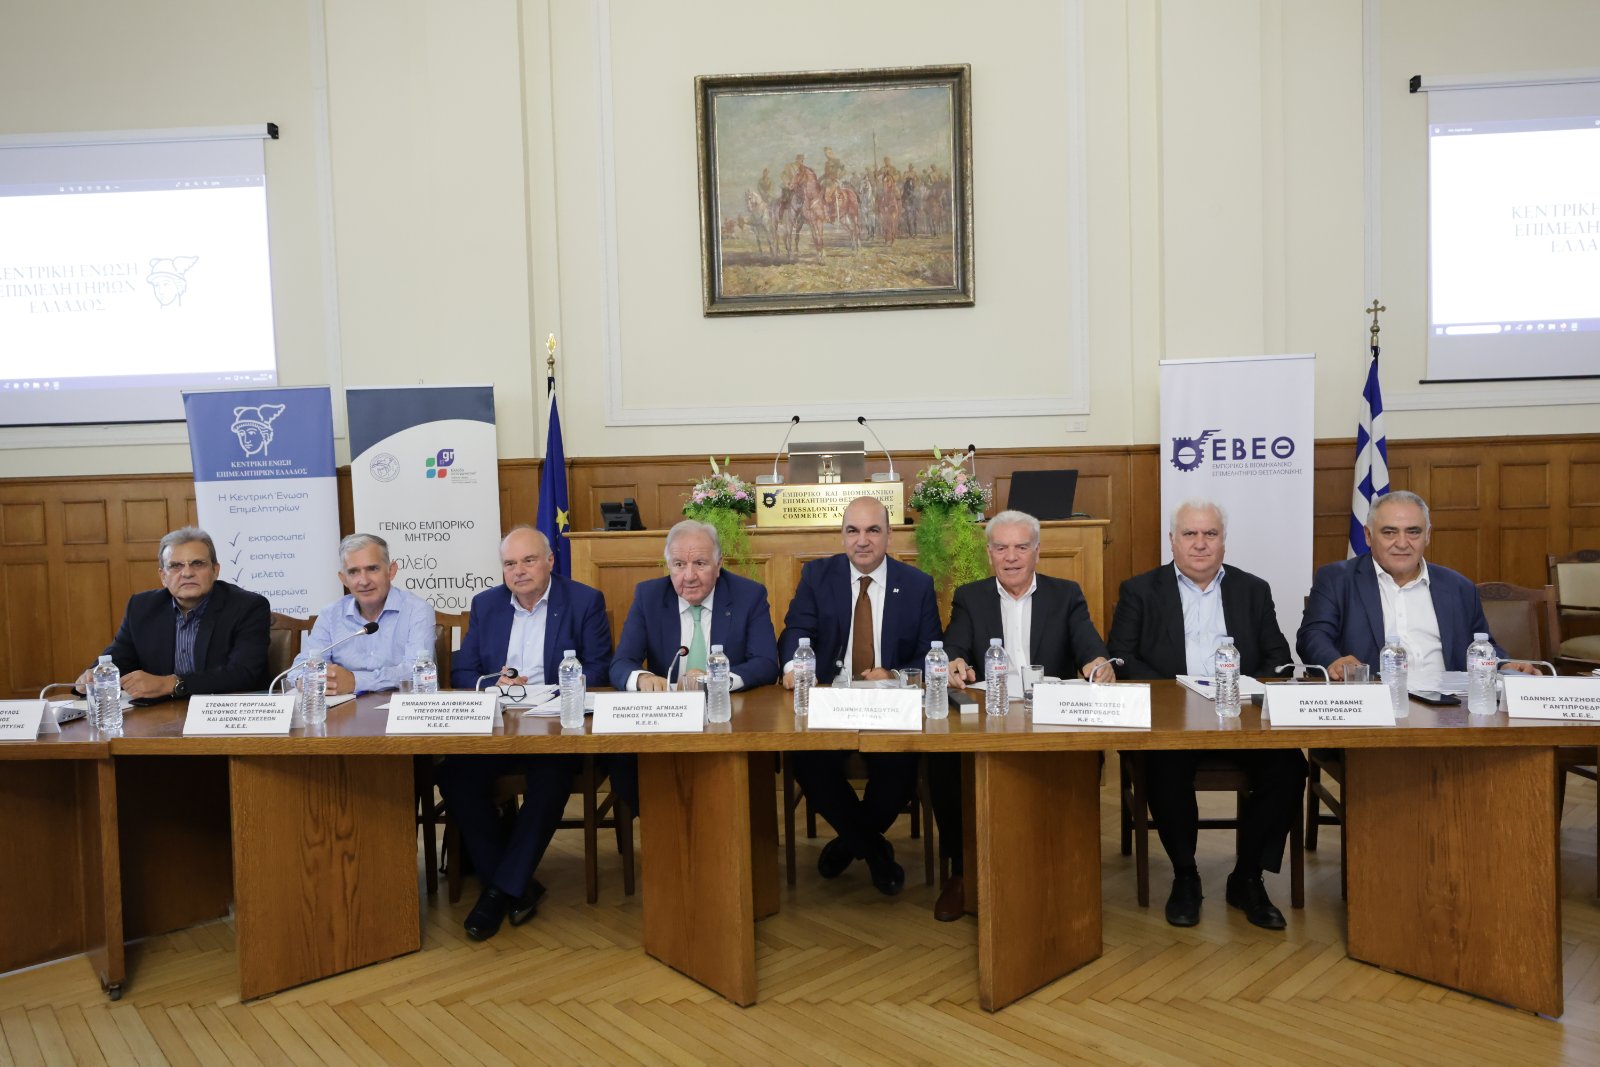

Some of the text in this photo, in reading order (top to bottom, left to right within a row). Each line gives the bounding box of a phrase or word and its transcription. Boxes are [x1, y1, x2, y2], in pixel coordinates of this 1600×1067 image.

[1515, 220, 1600, 237] ΕΠΙΜΕΛΗ
[1552, 238, 1599, 254] ΕΛΛΑ
[0, 262, 138, 280] ΕΝΤΡΙΚΗ ΕΝΩΣΗ
[29, 298, 106, 314] ΕΛΛΑΔΟΣ
[1212, 436, 1295, 460] ΕΒΕΘ
[231, 460, 268, 468] ΚΕΝΤΡΙΚΗ
[216, 470, 276, 478] ΕΠΙΜΕΛΗΤΗΡΙΩΝ
[229, 492, 273, 502] Κεντρική
[274, 492, 308, 500] Ένωση
[229, 504, 300, 515] Επιμελητηρίων
[379, 520, 474, 531] ΓΕΝΙΚΟ ΕΜΠΟΡΙΚΟ
[248, 533, 305, 544] εκπροσωπεί
[405, 533, 450, 542] ΜΗΤΡΩΟ
[250, 552, 295, 562] εισηγείται
[396, 554, 437, 570] αλείο
[406, 572, 494, 591] ανάπτυξης
[426, 594, 467, 608] όδου
[272, 605, 309, 614] στηρίζει
